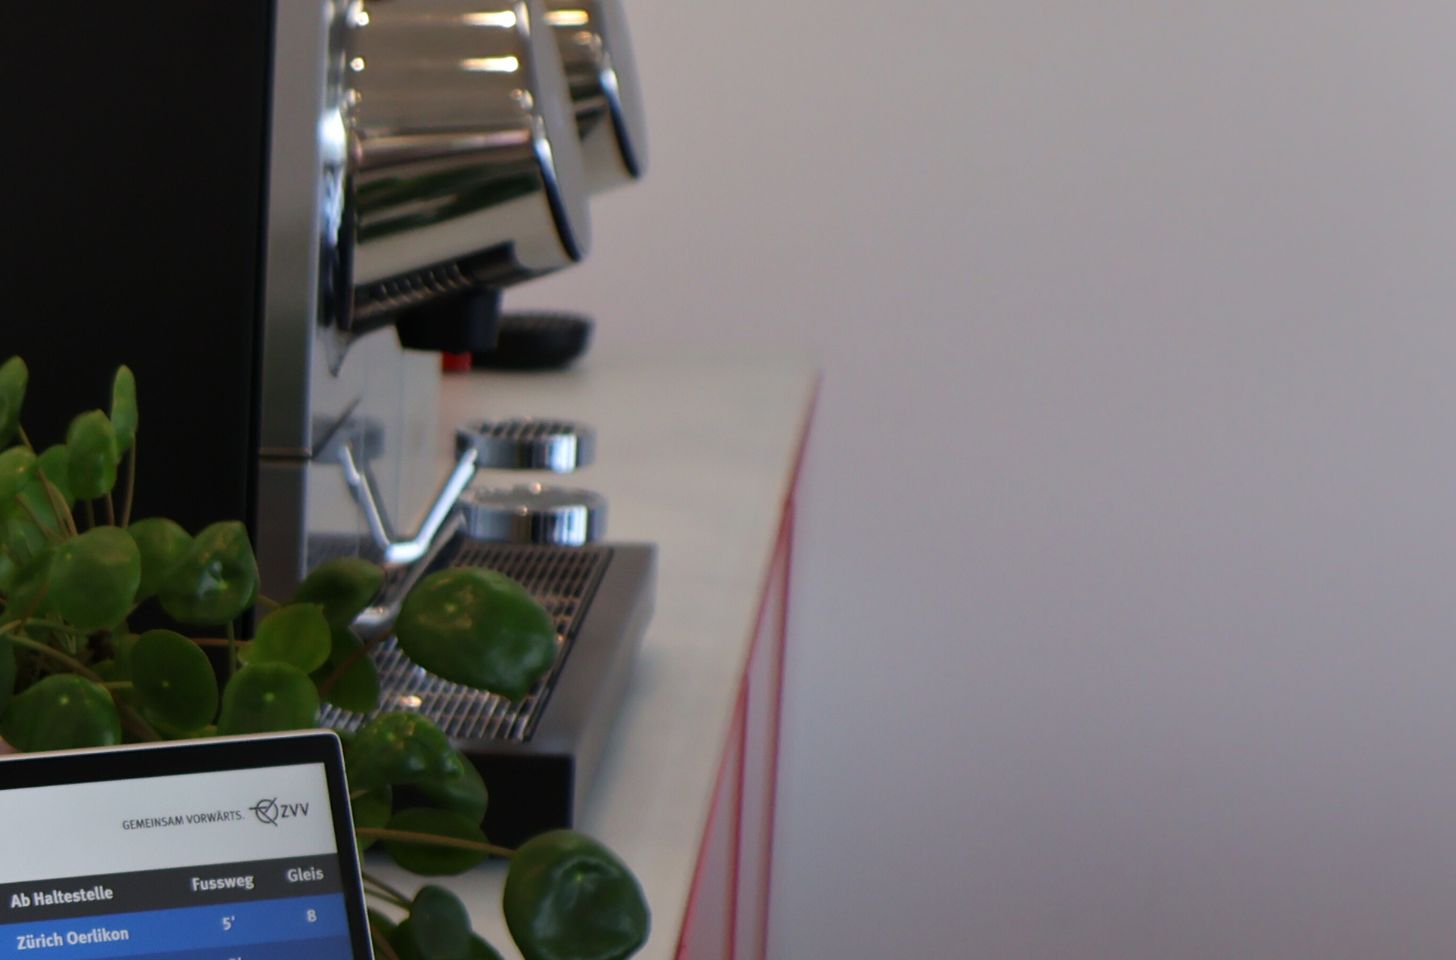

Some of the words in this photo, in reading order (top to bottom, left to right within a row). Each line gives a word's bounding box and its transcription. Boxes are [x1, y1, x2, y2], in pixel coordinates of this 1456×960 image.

[281, 803, 308, 818] ZVV
[123, 816, 183, 829] GEMEINSAM
[287, 867, 325, 882] Gleis
[191, 874, 255, 893] Fussweg
[10, 893, 31, 908] Ab
[34, 886, 114, 906] Haltestelle
[17, 932, 64, 951] Zürich
[67, 927, 129, 946] Oerlikon
